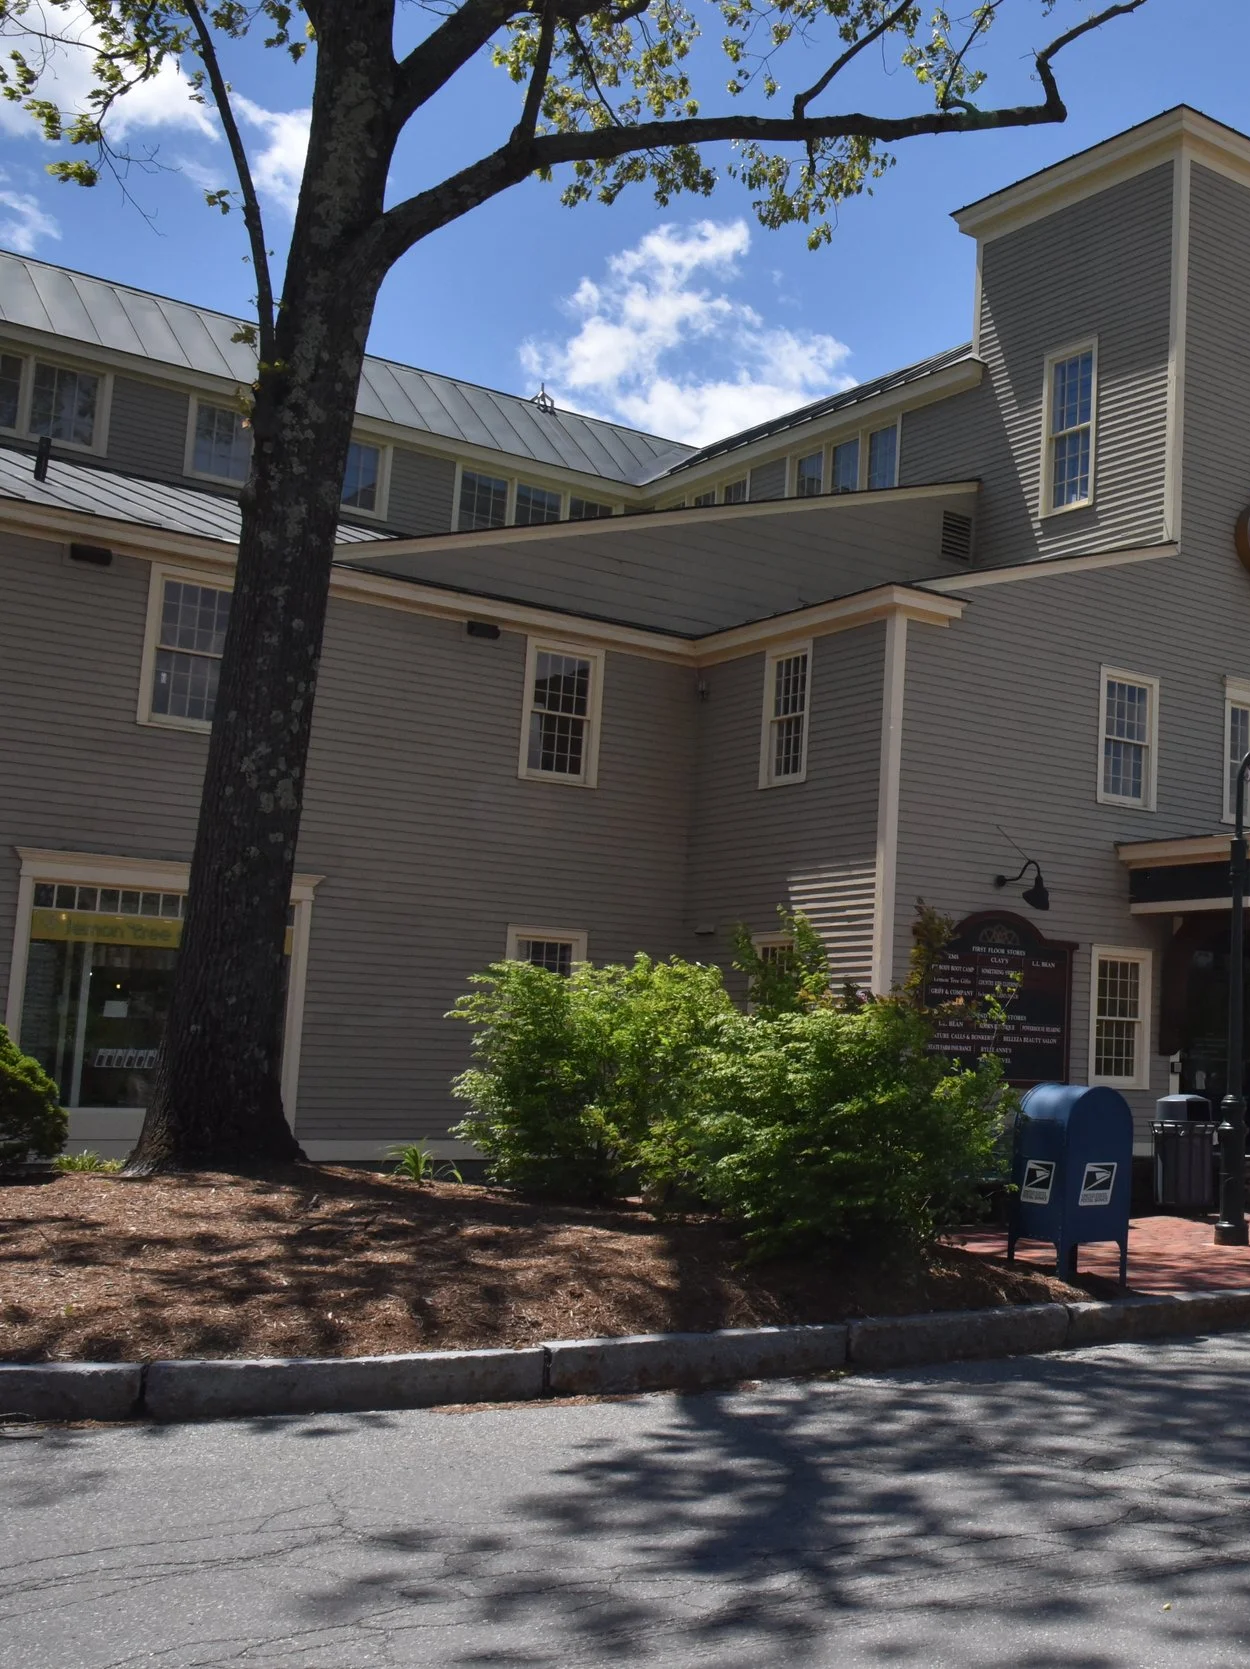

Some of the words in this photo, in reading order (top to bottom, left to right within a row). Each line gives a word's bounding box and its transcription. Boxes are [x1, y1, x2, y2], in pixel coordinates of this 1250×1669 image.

[972, 945, 986, 953] FIRST
[988, 947, 1005, 955] FLOOR
[1007, 949, 1026, 957] STORES
